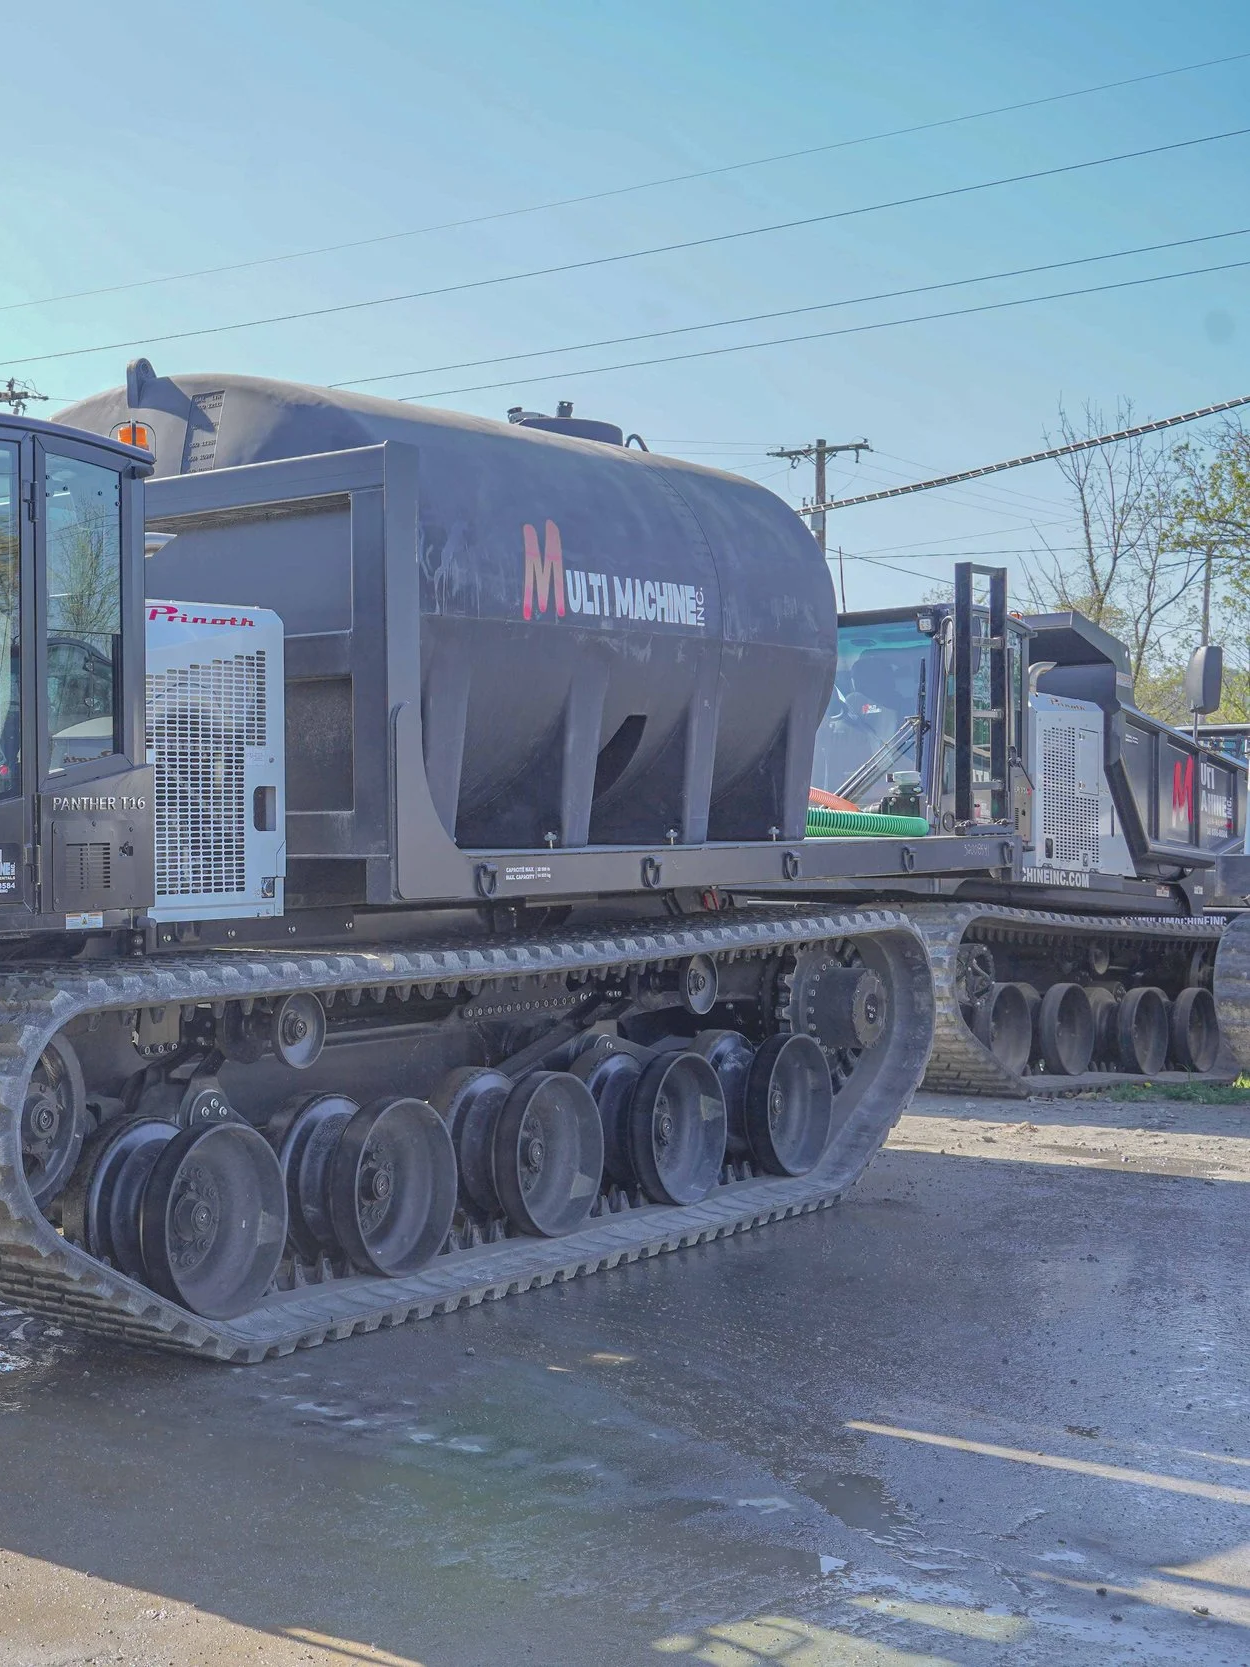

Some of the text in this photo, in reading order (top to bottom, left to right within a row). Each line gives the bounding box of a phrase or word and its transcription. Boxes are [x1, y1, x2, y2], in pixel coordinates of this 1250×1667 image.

[613, 575, 697, 626] MACHINE
[695, 587, 706, 627] INC.
[145, 605, 256, 627] Prinoth
[53, 796, 146, 811] PANTHER T16
